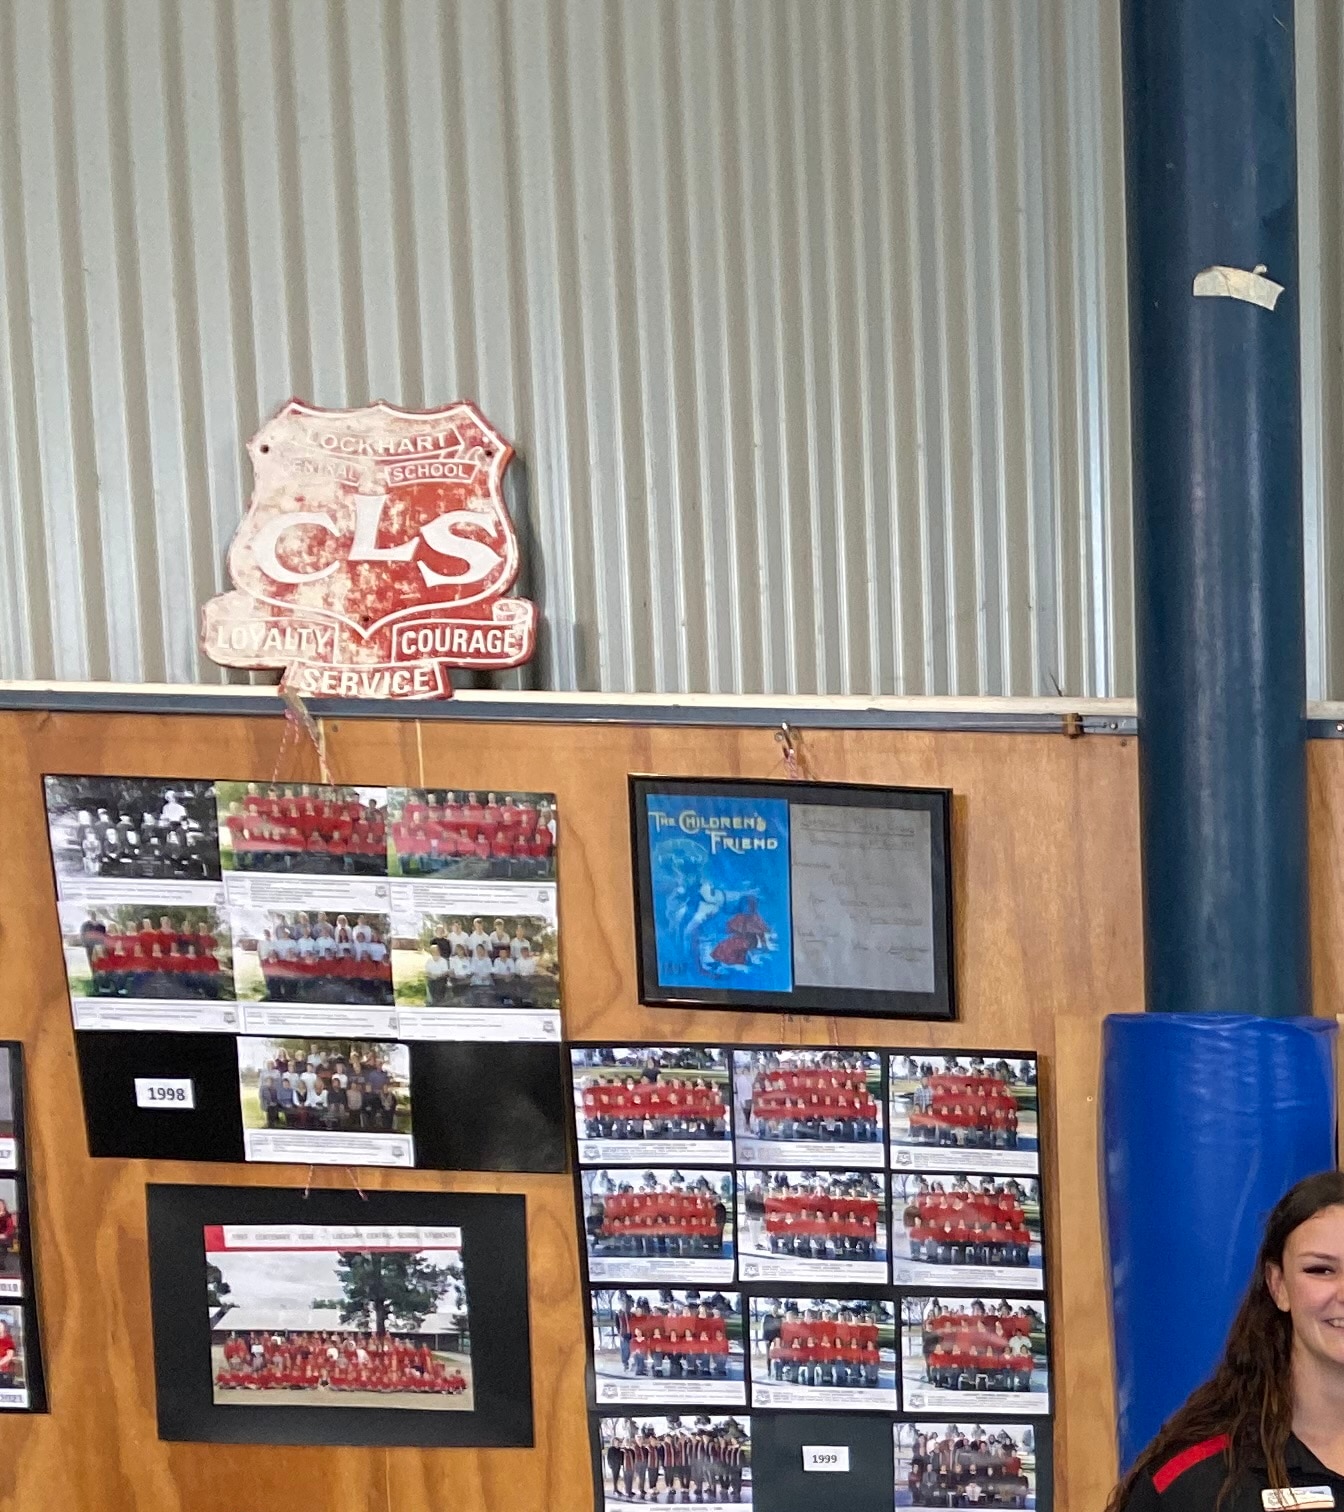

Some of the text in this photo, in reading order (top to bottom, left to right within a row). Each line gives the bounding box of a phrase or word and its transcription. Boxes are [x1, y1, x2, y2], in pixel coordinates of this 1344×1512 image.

[306, 429, 449, 457] LOCKHART
[393, 462, 469, 481] SCHOOL
[253, 494, 504, 588] CLS
[216, 624, 332, 654] LOYALTY
[401, 628, 517, 655] COURAGE
[303, 667, 429, 696] SERVICE
[705, 829, 778, 854] FRIEND
[147, 1087, 185, 1101] 1998
[812, 1454, 838, 1464] 1999
